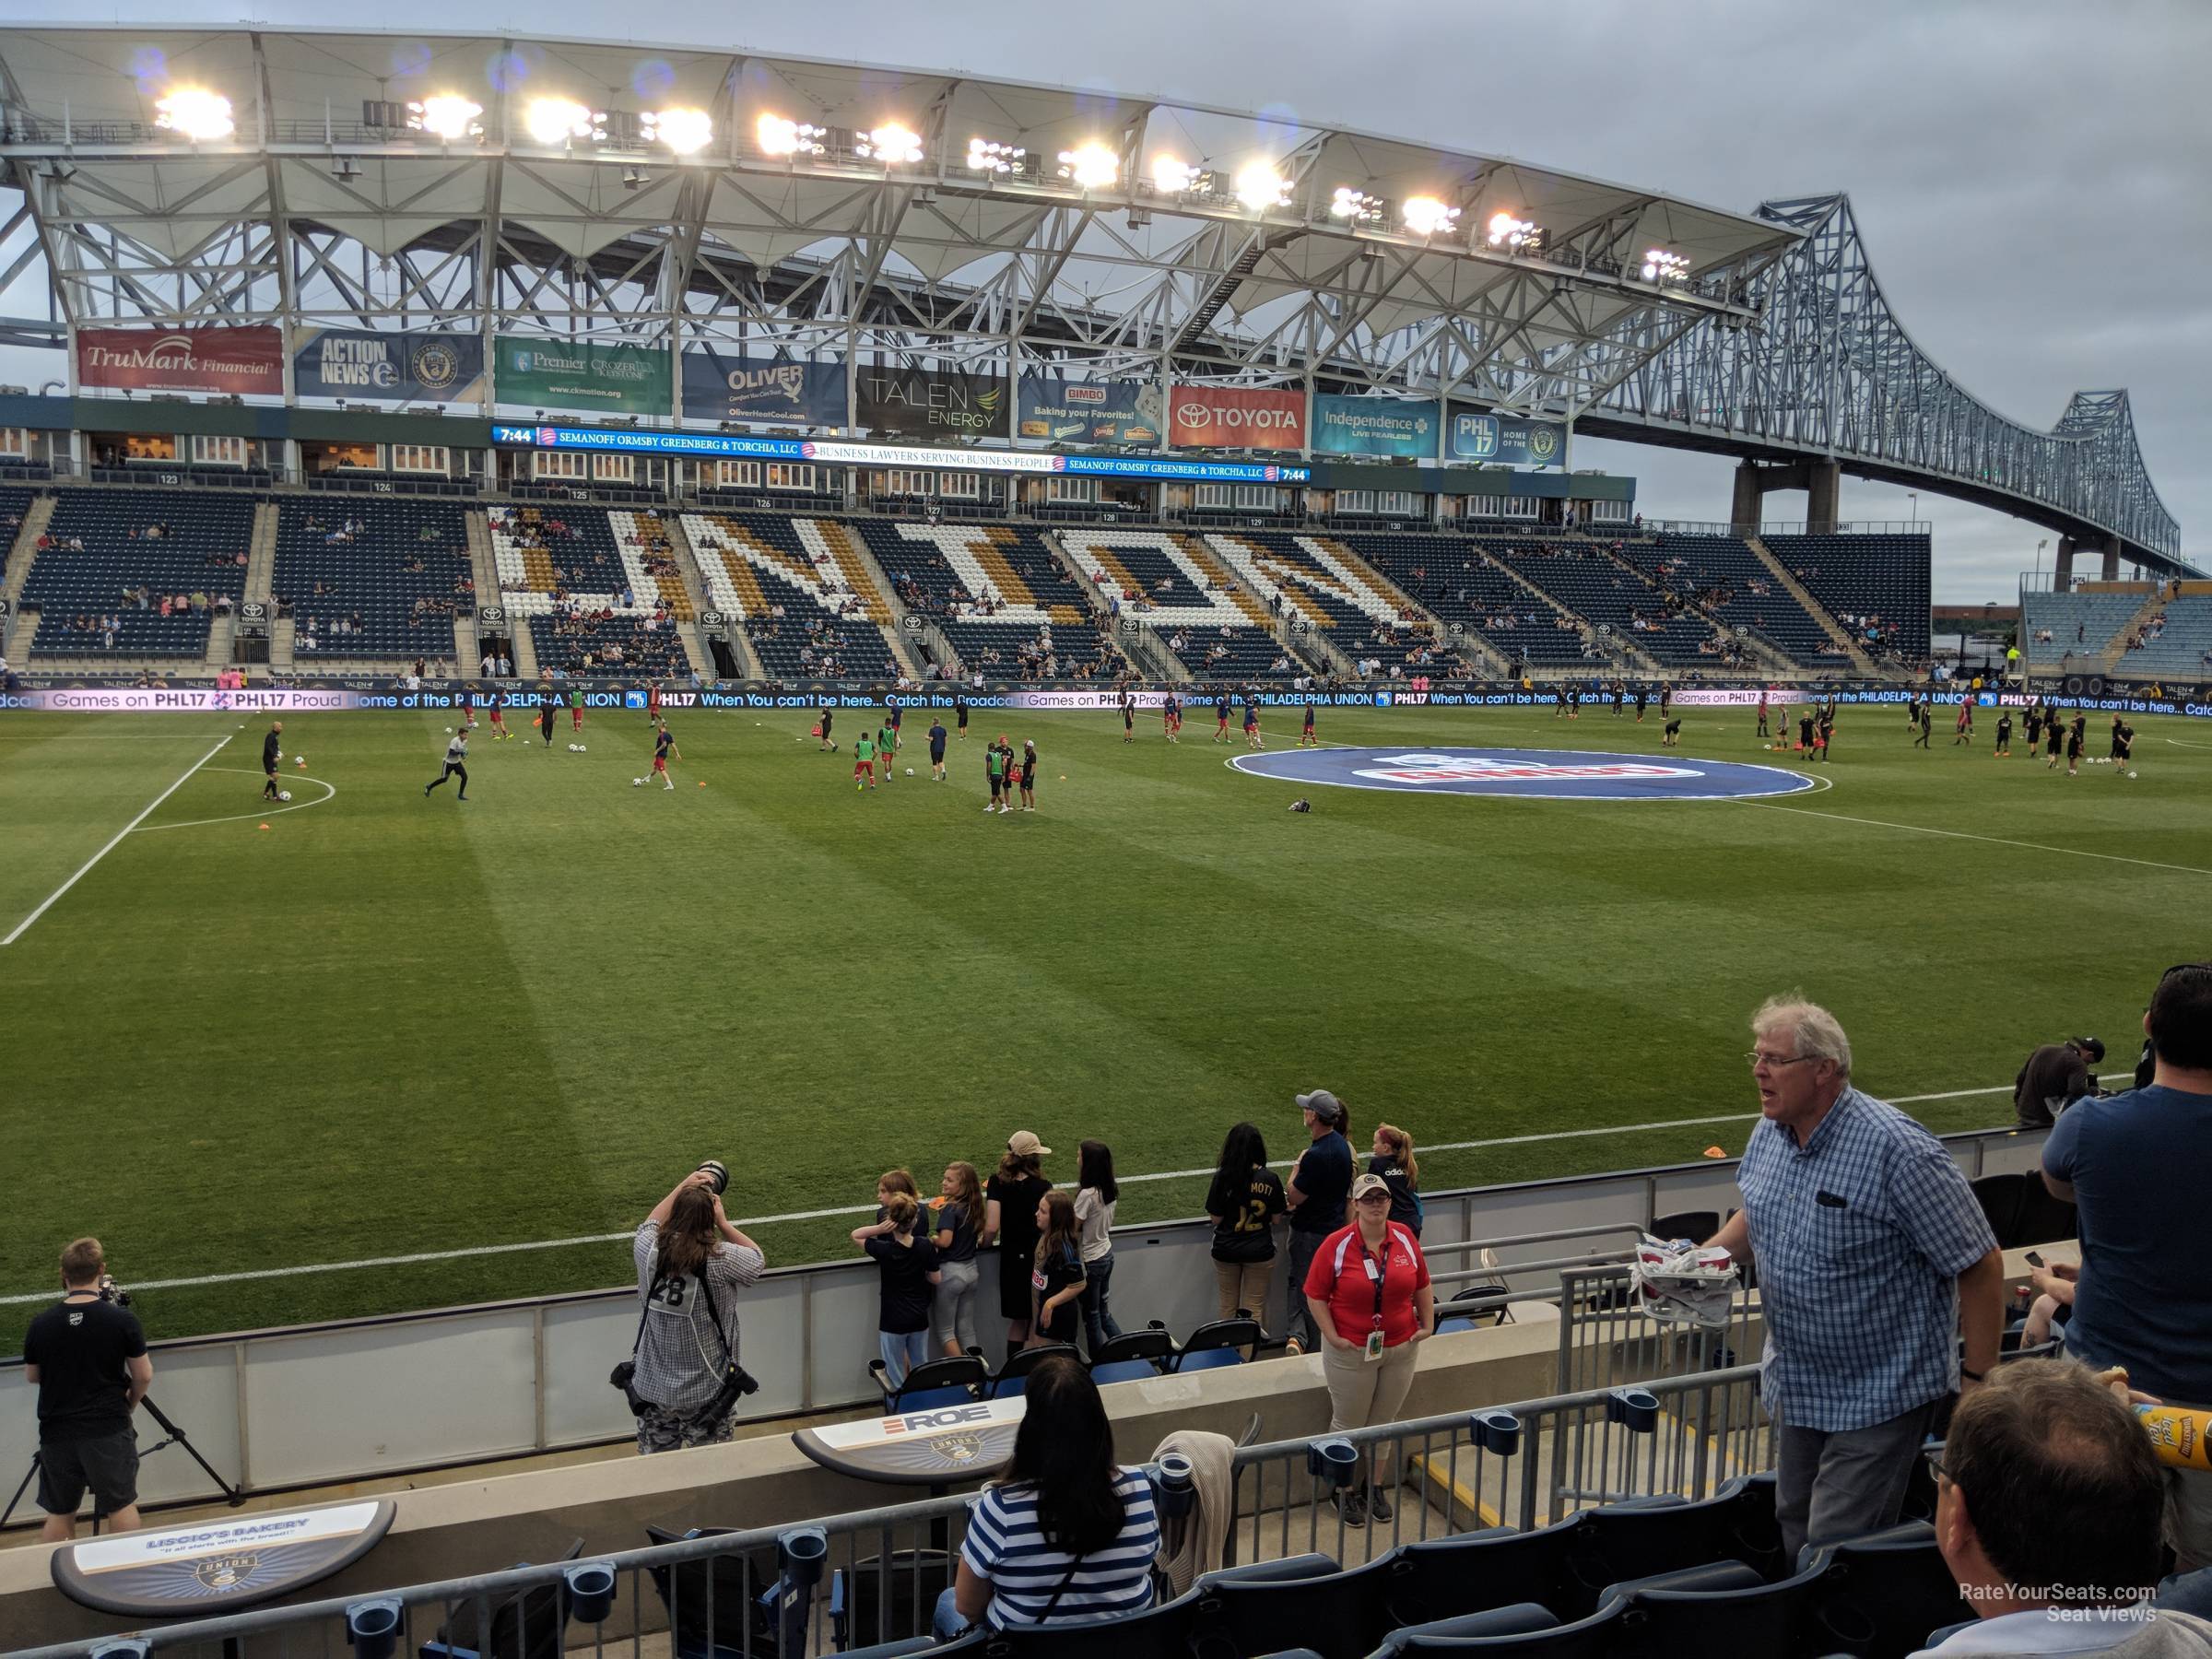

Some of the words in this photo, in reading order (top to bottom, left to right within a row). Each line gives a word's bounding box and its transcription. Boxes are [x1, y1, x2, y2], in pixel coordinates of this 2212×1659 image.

[323, 338, 387, 363] ACTION
[88, 346, 197, 371] TruMark
[203, 360, 269, 375] Financial
[533, 352, 587, 370] Premier
[322, 363, 370, 385] NEWS
[728, 365, 804, 390] OLIVER
[867, 378, 968, 409] TALEN
[1068, 388, 1104, 400] BIMBO
[729, 408, 806, 420] OliverHeatCool.com
[928, 411, 995, 429] ENERGY
[1034, 406, 1066, 418] Baking
[1068, 410, 1088, 418] your
[1091, 410, 1135, 420] Favorites!
[1212, 408, 1299, 429] TOYOTA
[1324, 411, 1413, 430] Independence
[1460, 418, 1493, 436] PHL
[500, 429, 532, 442] 7:44
[559, 431, 615, 444] SEMANOFF
[617, 435, 660, 446] ORMSBY
[661, 438, 721, 450] GREENBERG
[722, 441, 730, 450] &
[732, 441, 779, 454] TORCHIA,
[780, 443, 798, 454] LLC
[1371, 431, 1412, 441] FEARLESS
[1503, 431, 1526, 440] HOME
[1477, 436, 1493, 453] 17
[819, 446, 869, 458] BUSINESS
[871, 450, 919, 461] LAWYERS
[921, 452, 965, 464] SERVING
[967, 454, 1012, 466] BUSINESS
[1015, 457, 1051, 468] PEOPLE
[1069, 460, 1114, 471] SEMANOFF
[1116, 462, 1149, 473] ORMSBY
[1151, 464, 1199, 475] GREENBERG
[1200, 465, 1207, 475] &
[1208, 466, 1246, 477] TORCHIA,
[1247, 467, 1263, 477] LLC
[1283, 469, 1306, 480] 7:44
[160, 474, 179, 485] 123
[374, 482, 392, 493] 124
[572, 490, 587, 500] 125
[756, 500, 771, 508] 126
[1102, 513, 1115, 522] 128
[488, 506, 1434, 629] UNION
[53, 693, 120, 708] Games
[125, 696, 148, 707] on
[155, 693, 206, 707] PHL17
[235, 693, 286, 707] PHL17
[292, 693, 341, 707] Proud
[402, 693, 419, 707] of
[423, 693, 451, 707] the
[700, 693, 744, 707] When
[747, 693, 773, 707] You
[777, 693, 815, 707] can't
[818, 693, 838, 707] be
[841, 693, 883, 708] here...
[885, 693, 928, 707] Catch
[931, 694, 954, 707] the
[1029, 694, 1075, 706] Games
[1077, 697, 1094, 706] on
[1394, 693, 1428, 704] PHL17
[1430, 693, 1462, 705] When
[1463, 693, 1484, 704] You
[1487, 692, 1515, 704] can't
[1517, 692, 1531, 704] be
[1675, 693, 1712, 704] Games
[1713, 695, 1726, 703] on
[1729, 693, 1757, 703] PHL17
[1771, 693, 1798, 703] Proud
[1842, 692, 1858, 703] the
[2042, 695, 2077, 708] When
[2079, 698, 2098, 709] You
[2100, 699, 2129, 711] can't
[2132, 700, 2147, 712] be
[2148, 701, 2183, 714] here...
[1384, 767, 1681, 782] BIMBO
[649, 1277, 687, 1307] 28
[2147, 1422, 2162, 1447] Tea
[2161, 1417, 2178, 1447] Iced
[938, 1437, 973, 1448] UNION
[146, 1530, 231, 1549] LISCIO'S
[232, 1518, 310, 1537] BAKERY
[187, 1542, 215, 1550] starts
[217, 1538, 239, 1547] with
[206, 1558, 249, 1571] UNION
